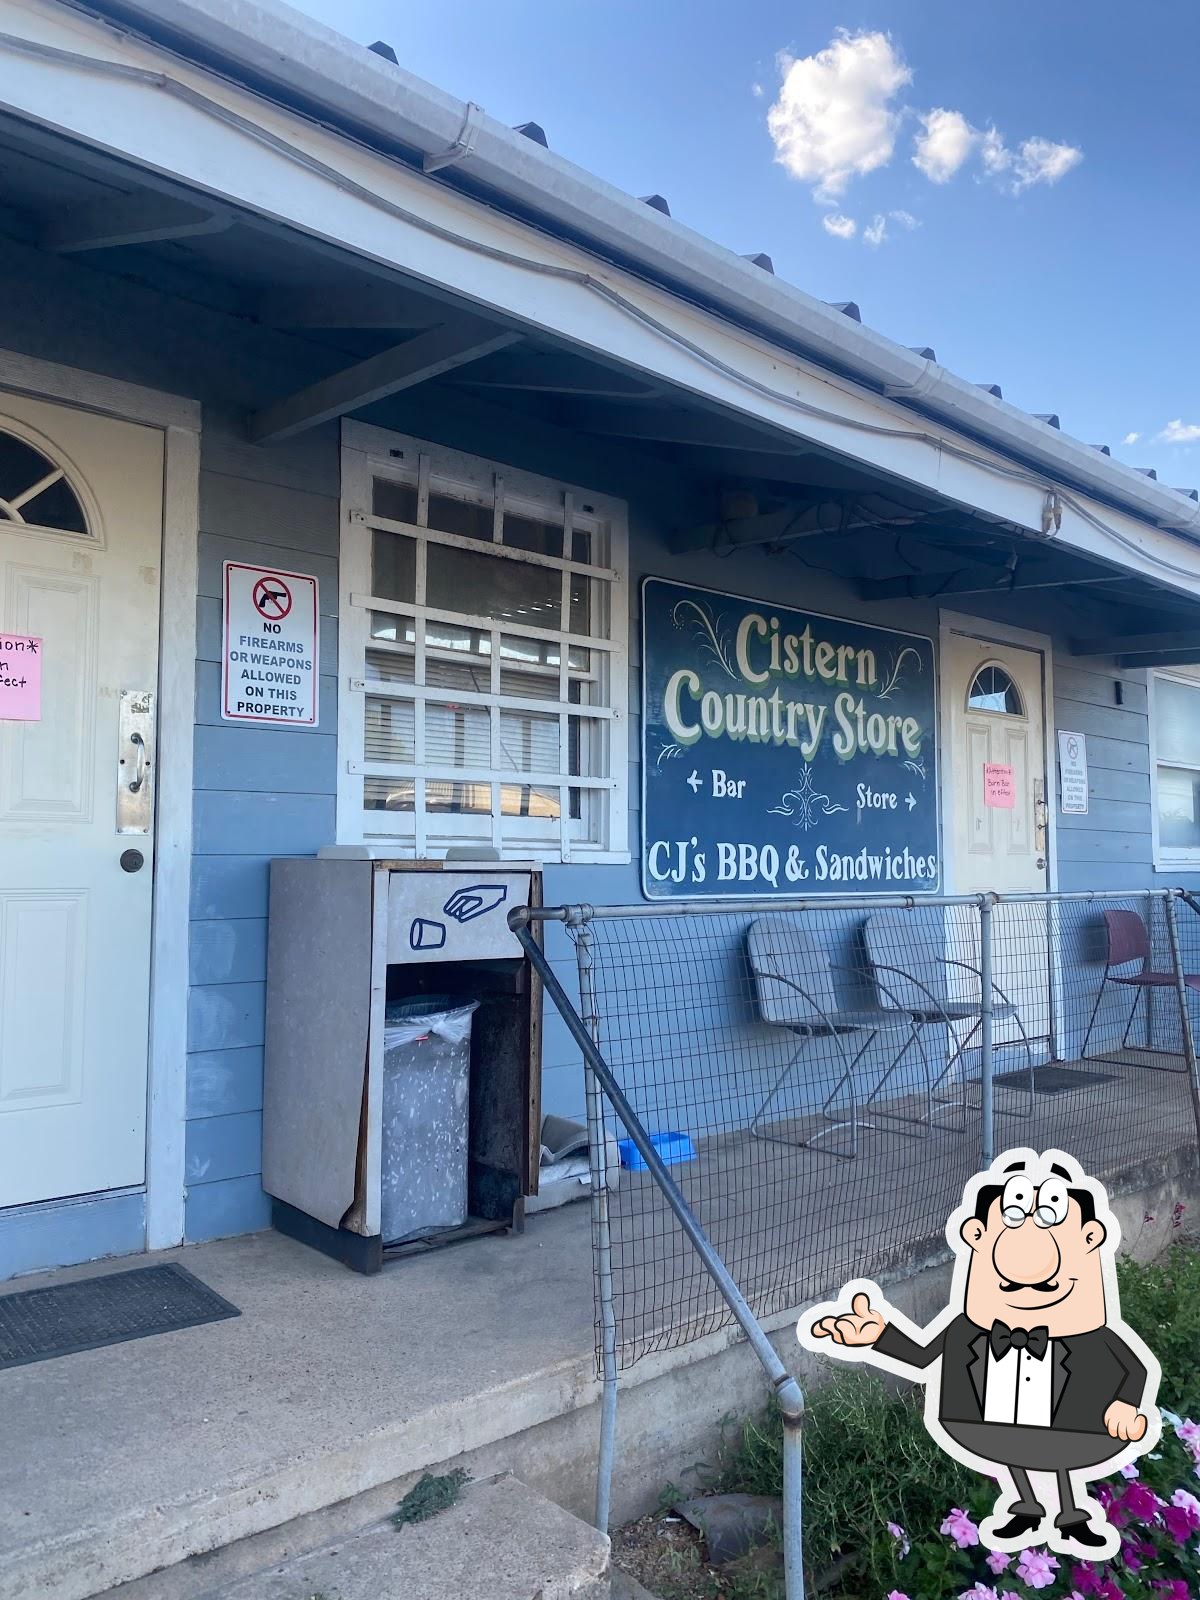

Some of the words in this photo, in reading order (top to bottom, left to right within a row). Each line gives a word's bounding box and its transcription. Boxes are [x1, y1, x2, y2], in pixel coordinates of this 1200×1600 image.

[263, 622, 282, 634] NO
[239, 635, 304, 654] FIREARMS
[736, 613, 878, 687] Cistern
[230, 651, 248, 663] OR
[251, 653, 312, 671] WEAPONS
[241, 669, 301, 685] ALLOWED
[245, 686, 264, 698] ON
[268, 688, 297, 701] THIS
[237, 701, 305, 718] PROPERTY
[664, 669, 828, 757] Country
[833, 692, 921, 756] Store
[712, 769, 747, 799] Bar
[856, 782, 898, 809] Store
[648, 836, 707, 883] CJ's
[717, 842, 780, 888] BBQ
[785, 845, 810, 882] &
[815, 844, 937, 882] Sandwiches
